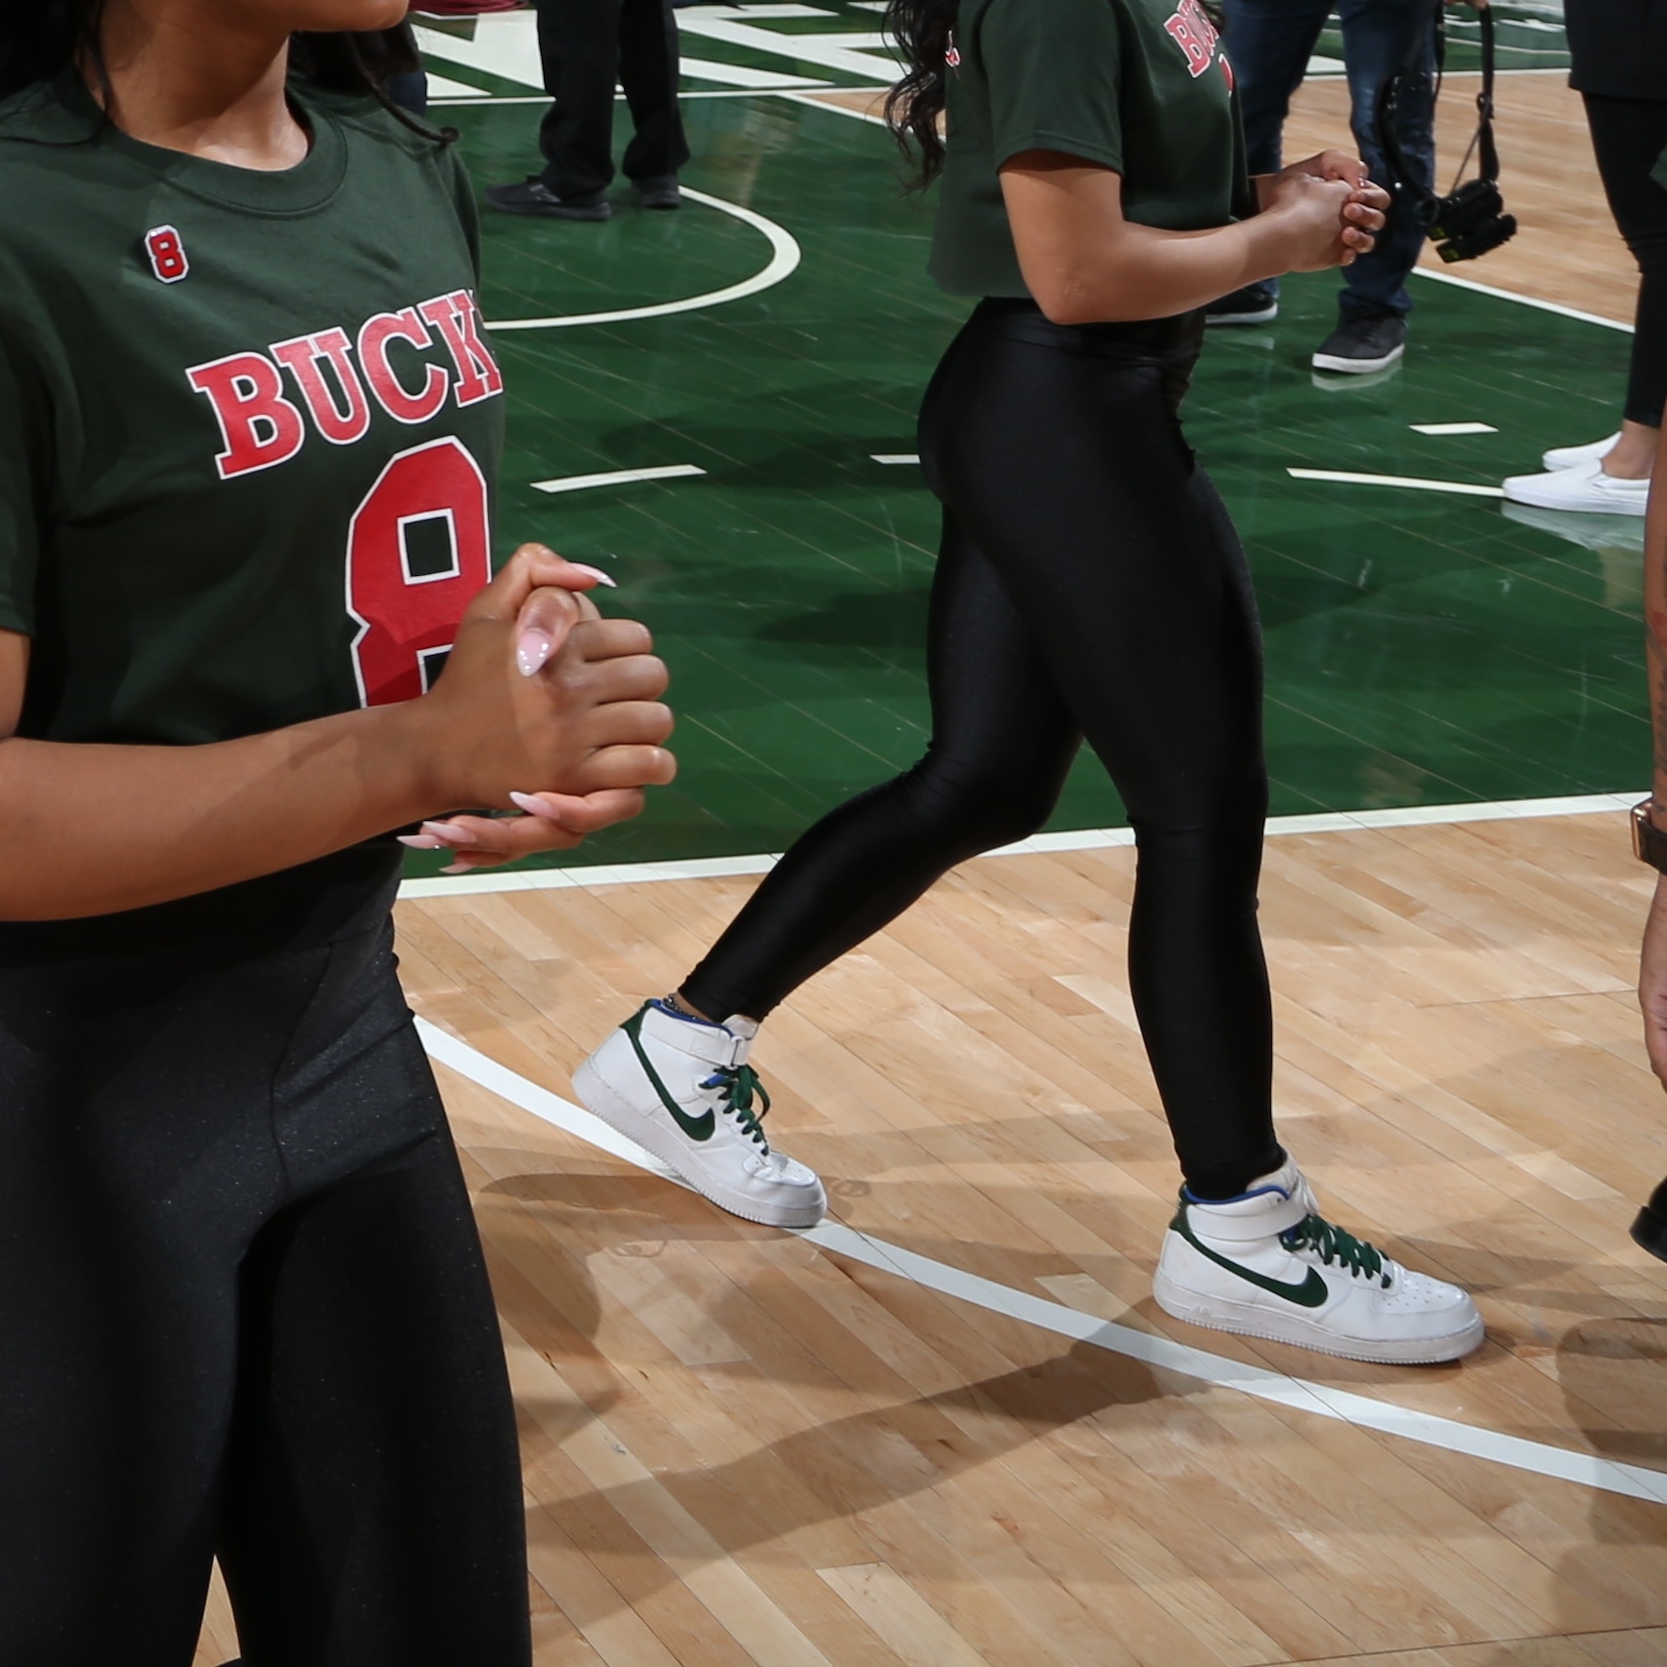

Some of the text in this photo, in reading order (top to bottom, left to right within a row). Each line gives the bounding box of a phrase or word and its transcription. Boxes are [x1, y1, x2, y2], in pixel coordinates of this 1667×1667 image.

[144, 224, 190, 284] 8
[185, 289, 504, 481] BUCK
[345, 435, 494, 710] 8
